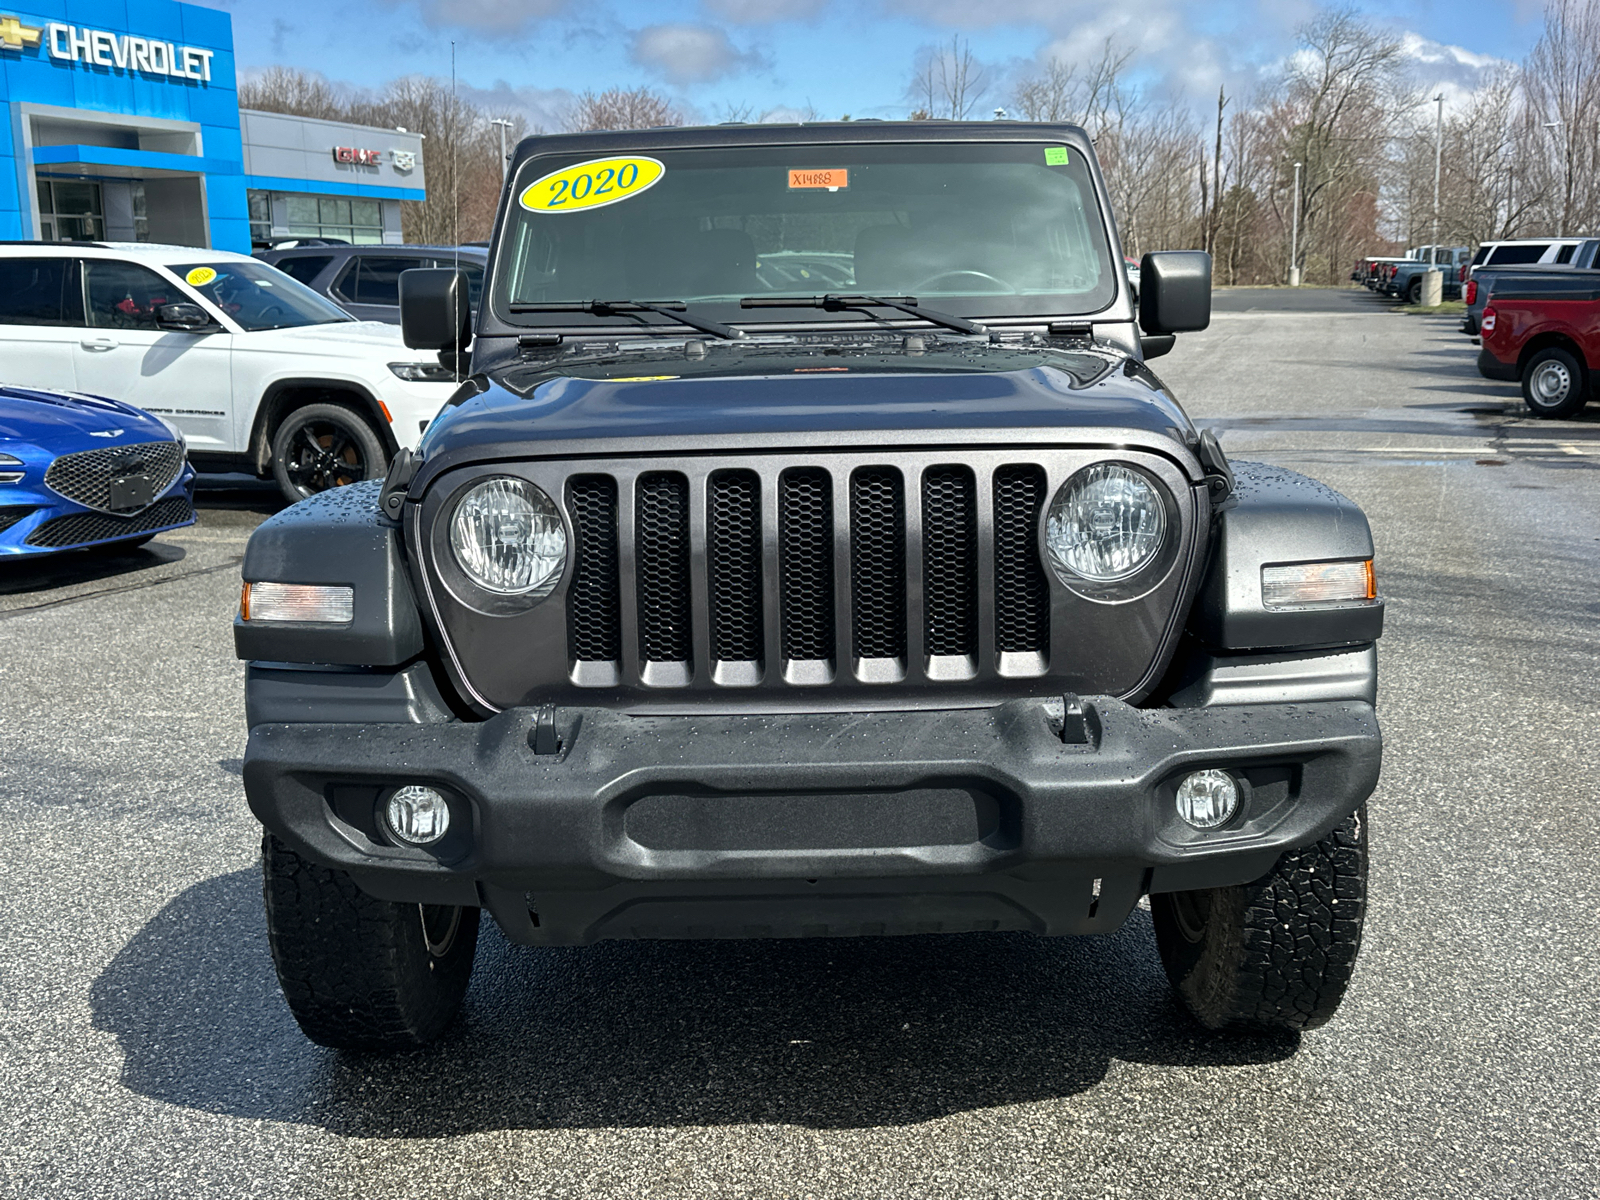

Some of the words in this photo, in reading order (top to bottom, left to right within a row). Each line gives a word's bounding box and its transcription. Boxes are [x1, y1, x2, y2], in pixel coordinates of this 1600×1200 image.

[48, 22, 214, 82] CHEVROLET
[336, 146, 382, 165] GMC
[547, 163, 639, 207] 2020
[793, 171, 832, 185] X14888
